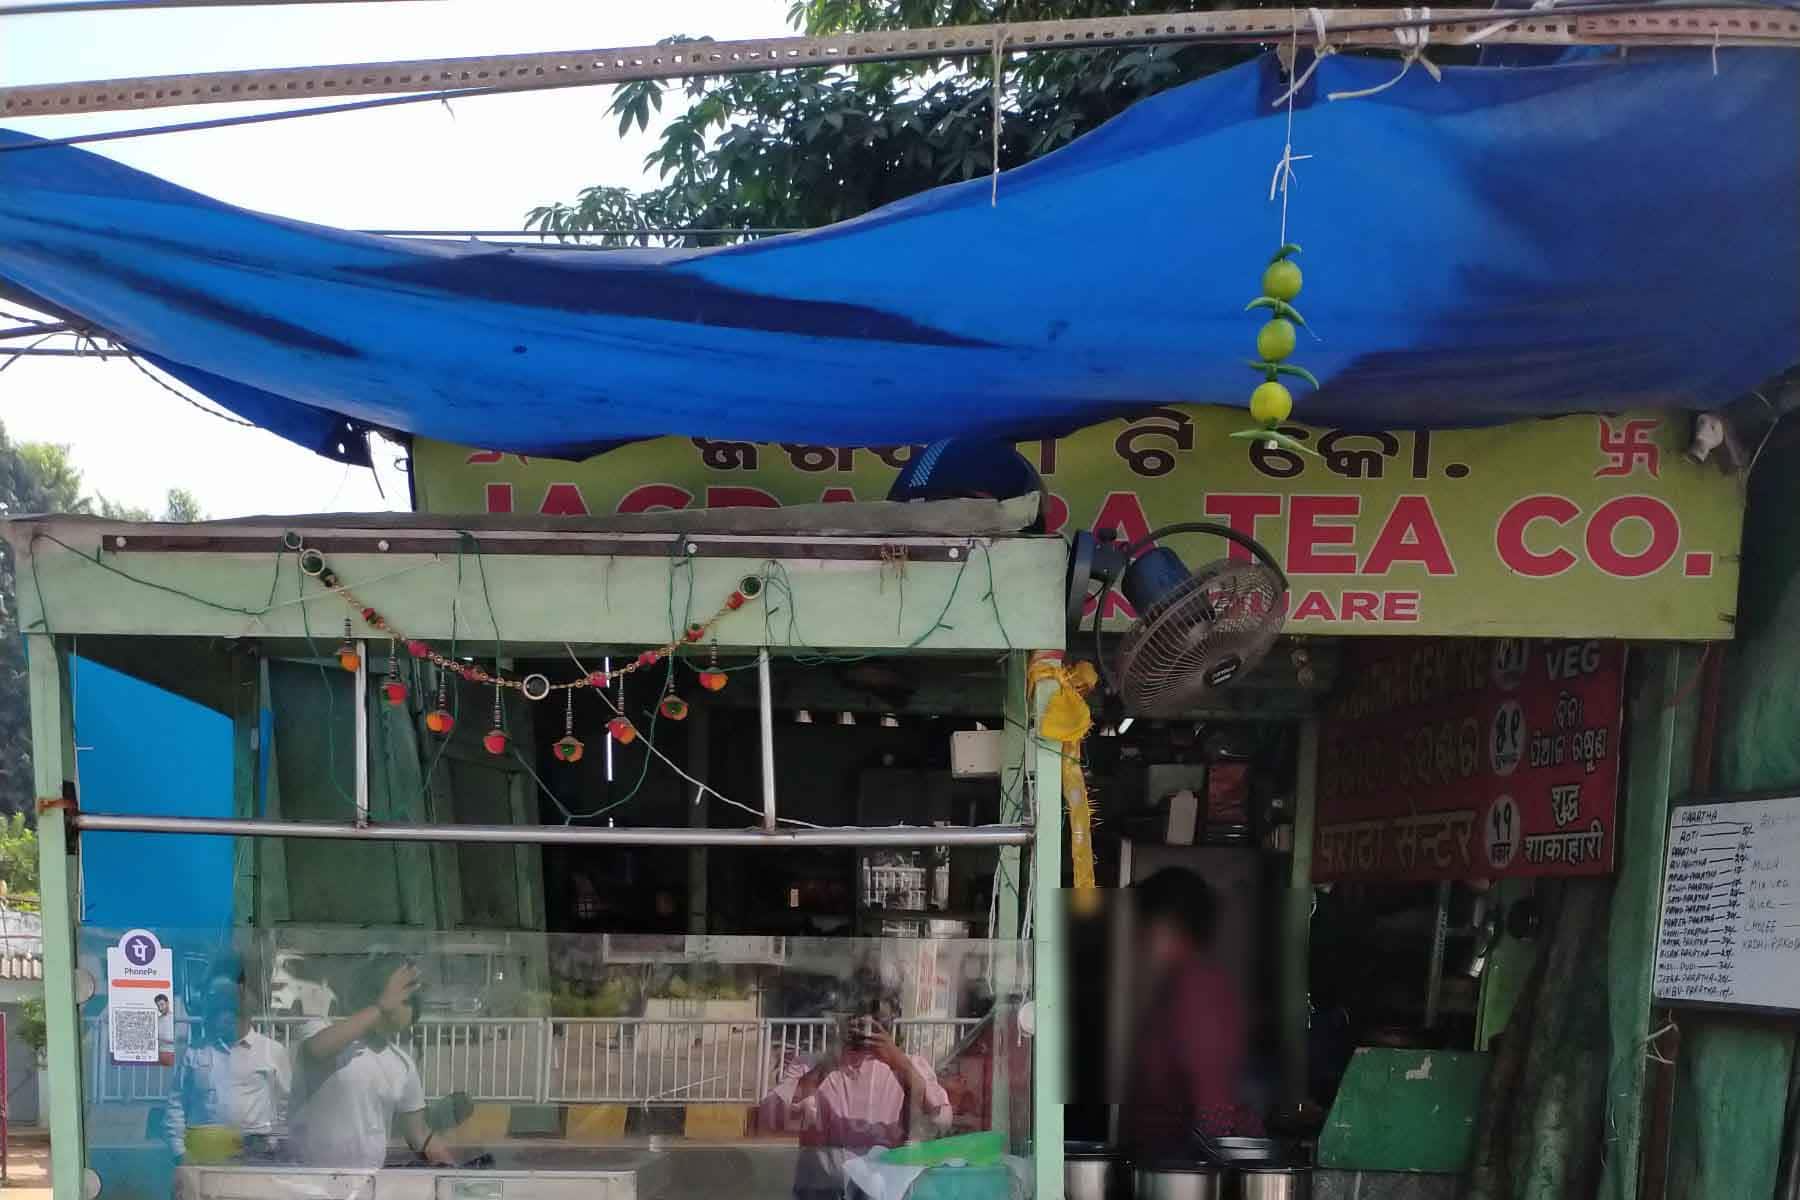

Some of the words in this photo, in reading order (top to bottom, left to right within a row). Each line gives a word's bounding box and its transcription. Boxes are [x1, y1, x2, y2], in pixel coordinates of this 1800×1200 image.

[1204, 494, 1456, 577] TEA
[1496, 494, 1713, 578] CO.
[1545, 641, 1600, 681] VEG
[1524, 819, 1604, 865] शाकाहारी
[1679, 831, 1699, 846] ROTI
[131, 938, 148, 962] पे
[124, 967, 157, 977] PhonePe
